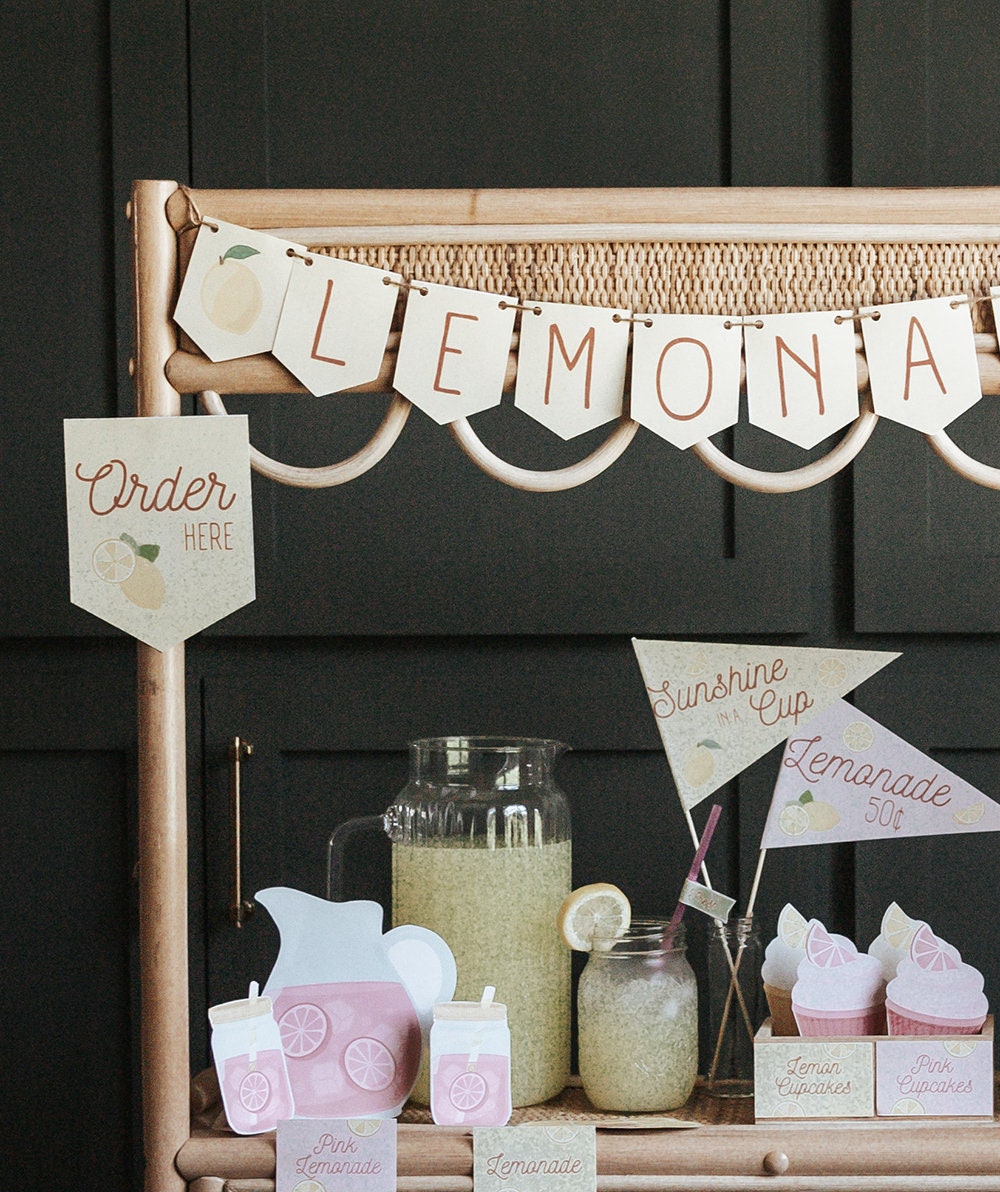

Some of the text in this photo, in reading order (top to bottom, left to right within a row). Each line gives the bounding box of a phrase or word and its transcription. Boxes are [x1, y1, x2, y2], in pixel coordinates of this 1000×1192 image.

[75, 459, 236, 516] Order
[184, 521, 234, 551] HERE
[647, 658, 789, 719] Sunshine
[716, 688, 814, 727] IN A Cup
[783, 735, 953, 808] Lemonade
[864, 796, 905, 832] 50¢
[786, 1055, 842, 1080] Lemon
[911, 1054, 954, 1075] Pink
[775, 1076, 852, 1100] Cupcakes
[896, 1074, 974, 1099] Cupcakes
[313, 1133, 358, 1155] Pink
[295, 1154, 382, 1180] Lemonade
[486, 1152, 582, 1180] Lemonade
